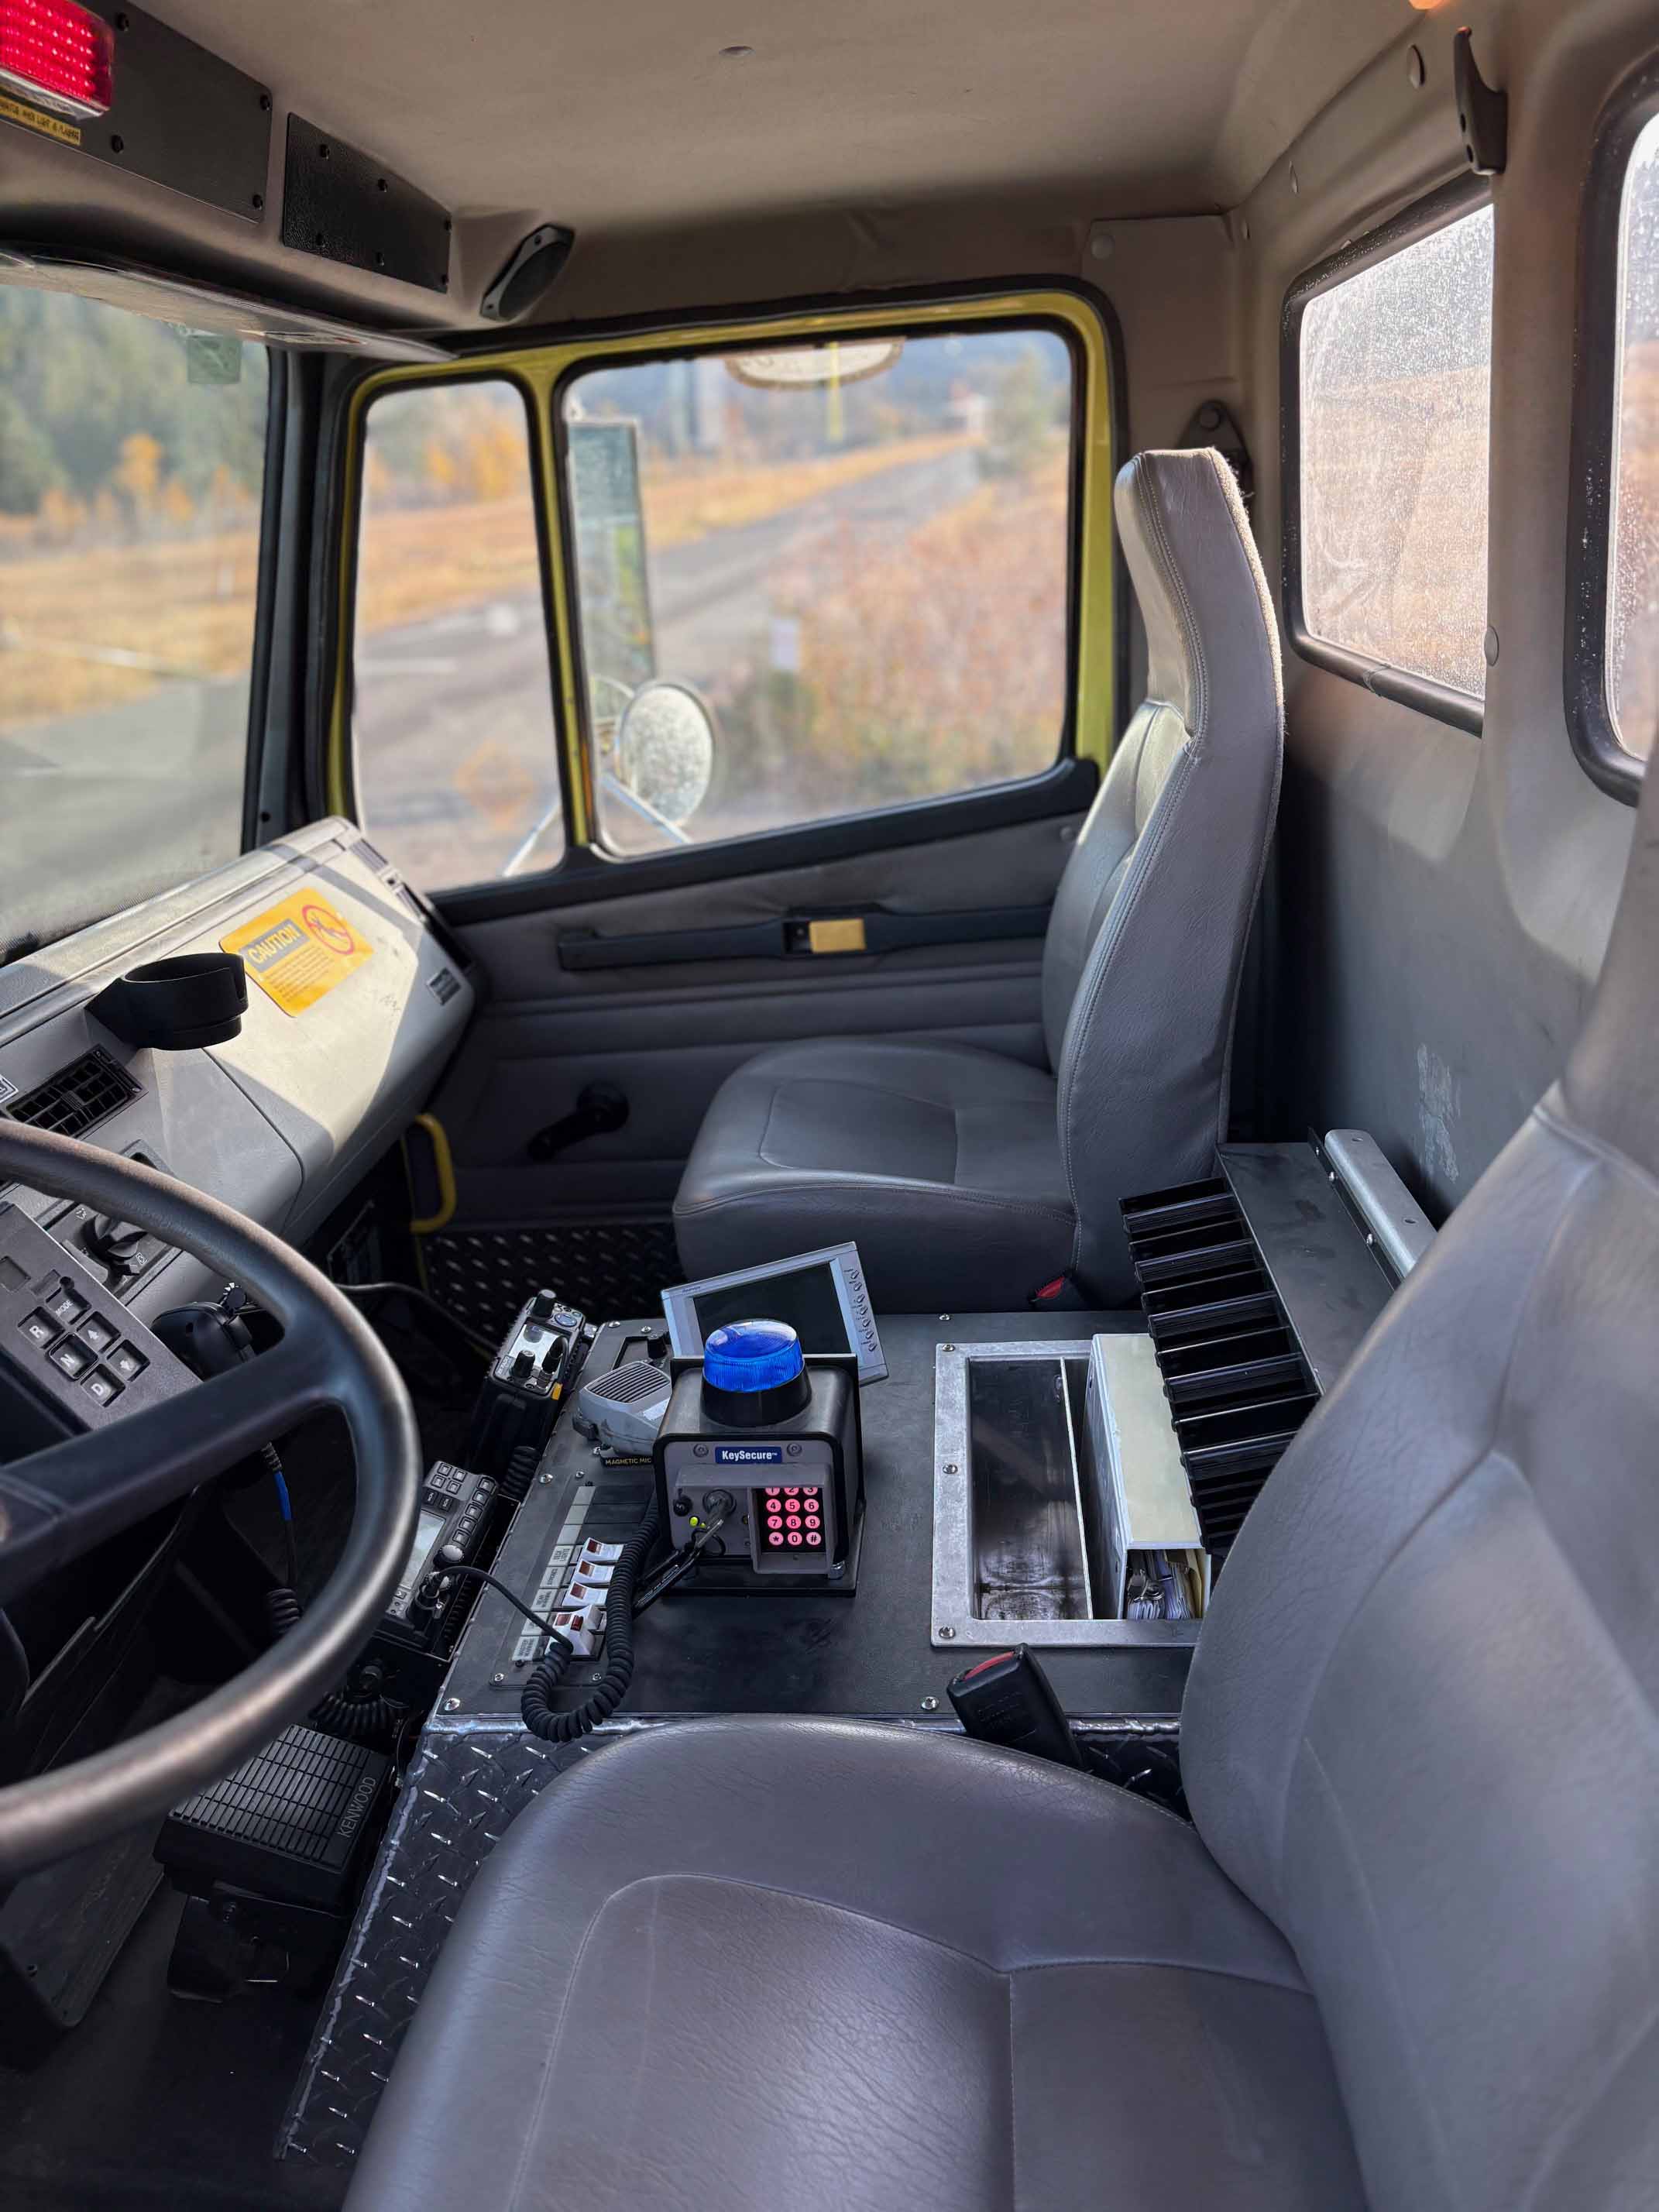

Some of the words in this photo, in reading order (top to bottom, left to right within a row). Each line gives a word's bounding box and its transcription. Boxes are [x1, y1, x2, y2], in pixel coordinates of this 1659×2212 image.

[248, 925, 301, 964] CAUTION
[56, 1300, 74, 1317] MODE
[29, 1325, 44, 1339] R
[60, 1354, 75, 1367] N
[91, 1383, 104, 1396] D
[338, 1777, 376, 1838] KENWOOD
